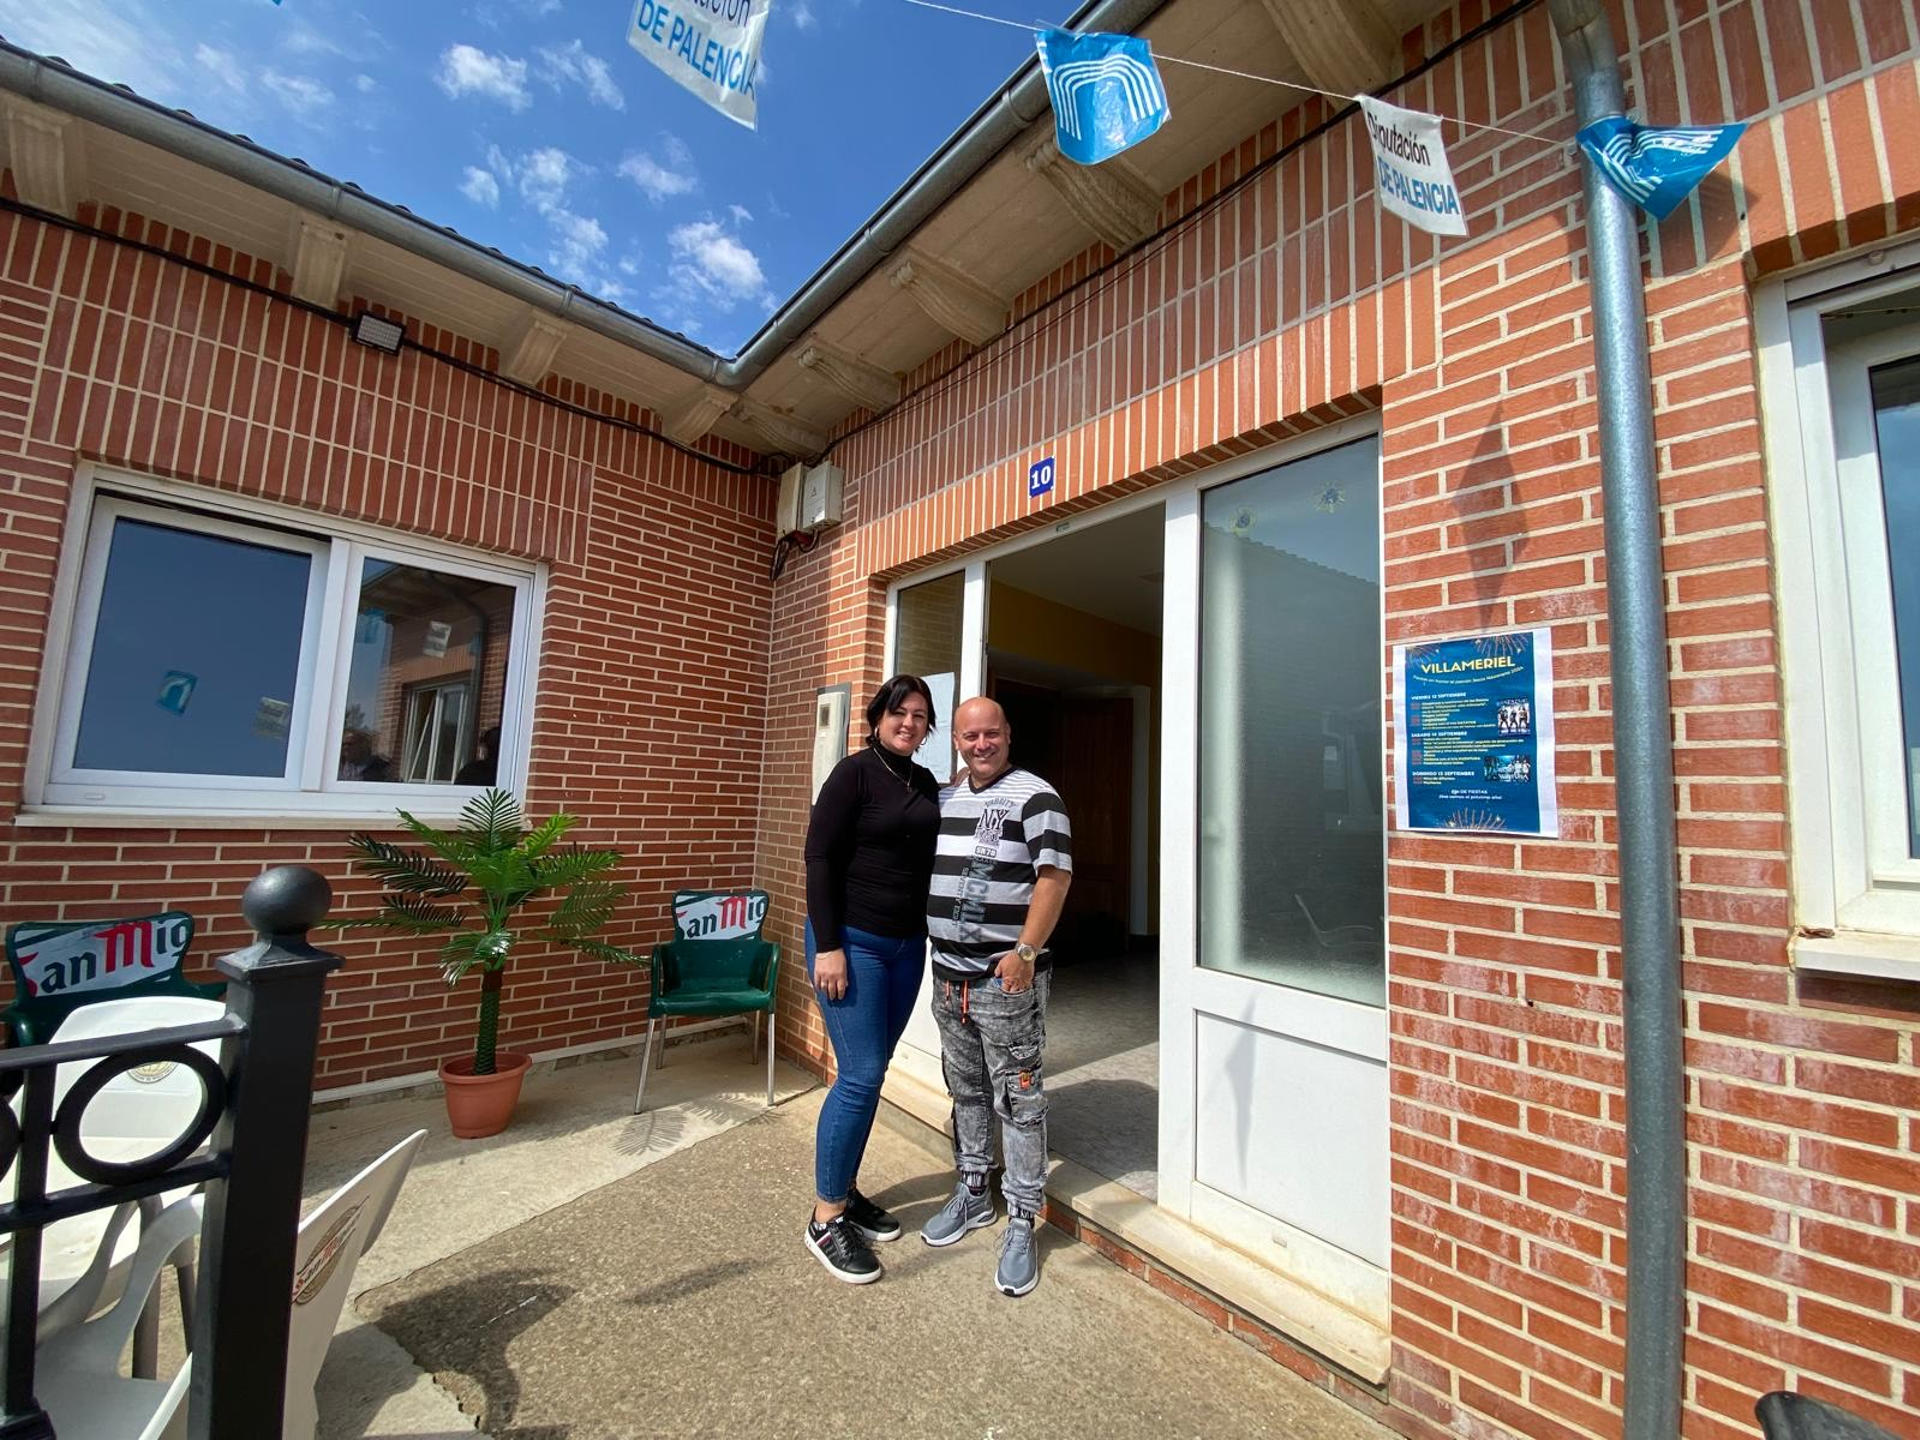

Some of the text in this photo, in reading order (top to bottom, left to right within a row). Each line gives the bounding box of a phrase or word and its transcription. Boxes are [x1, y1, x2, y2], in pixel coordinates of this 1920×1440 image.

[638, 0, 757, 101] DE PALENCIA
[1367, 112, 1431, 166] Diputación
[1377, 155, 1460, 215] DE PALENCIA
[1031, 465, 1051, 489] 10
[1421, 656, 1516, 674] VILLAMERIEL
